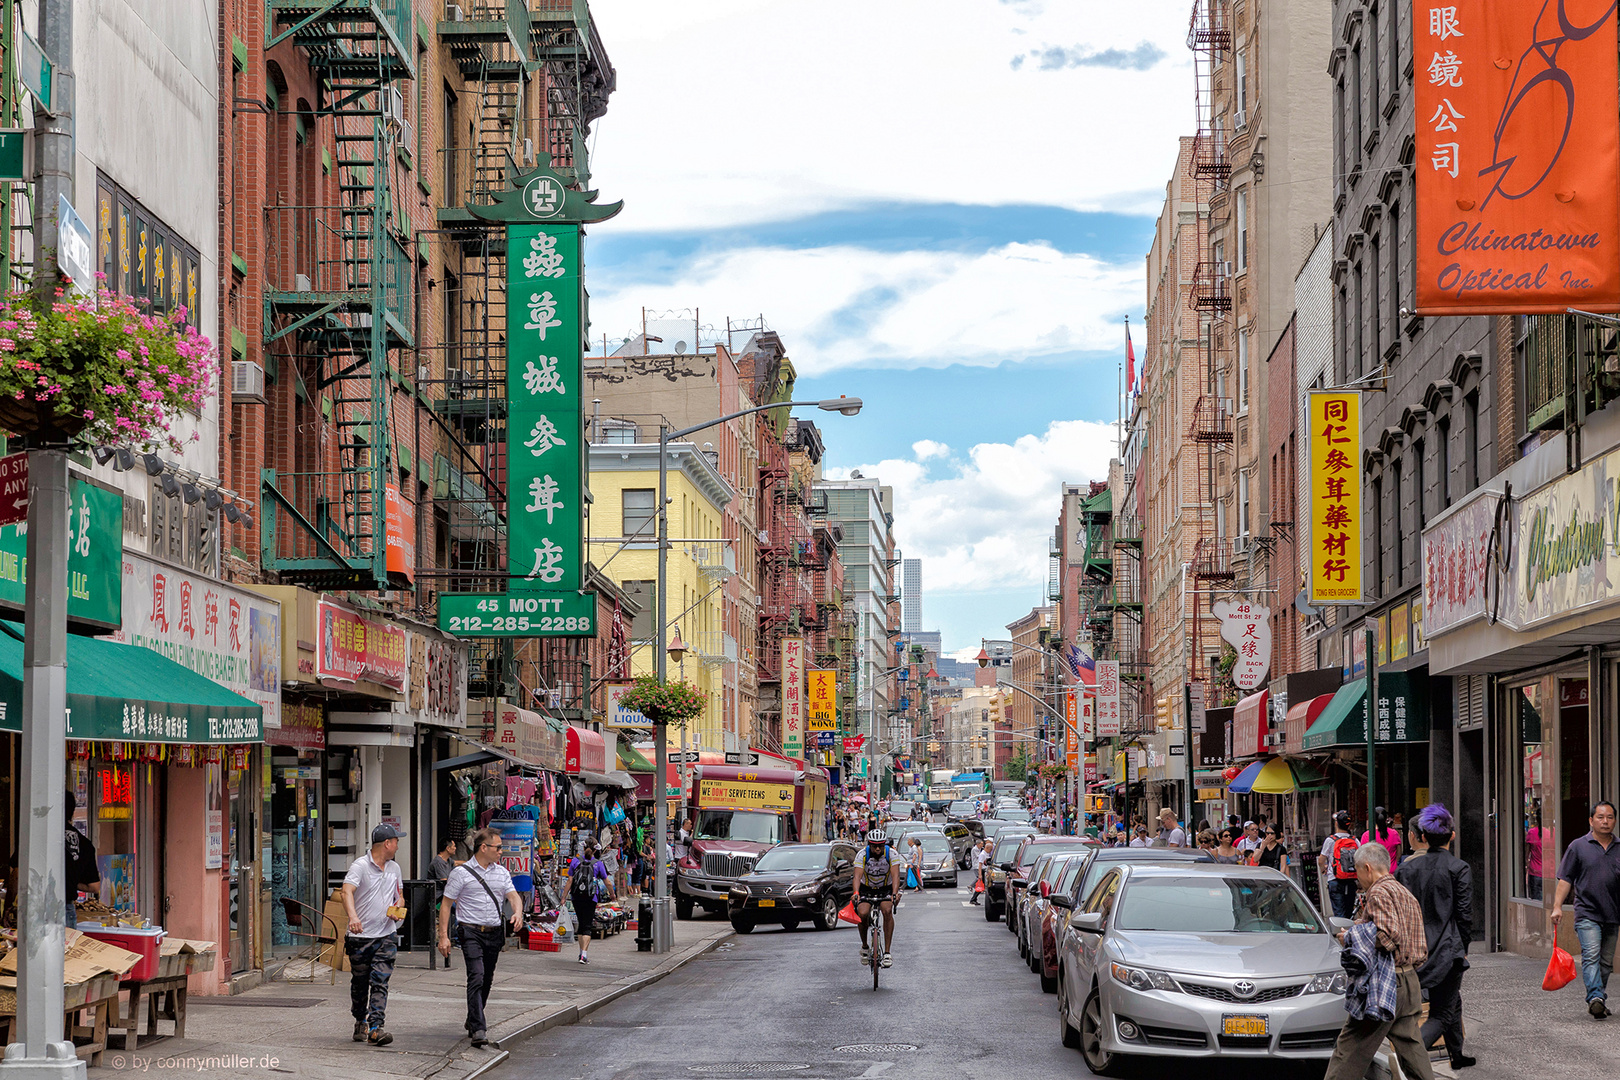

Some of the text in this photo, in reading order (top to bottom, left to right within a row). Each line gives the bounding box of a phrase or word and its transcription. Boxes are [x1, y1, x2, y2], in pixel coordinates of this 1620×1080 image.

[1437, 221, 1601, 256] Chinatown
[1437, 262, 1595, 299] Optical Inc.
[1526, 506, 1605, 602] Chinatown
[1338, 588, 1358, 597] GROCERY
[476, 598, 564, 613] 45 MOTT
[1237, 605, 1251, 613] 48
[449, 616, 591, 631] 212-285-2288
[815, 711, 830, 719] BIG
[207, 717, 222, 739] TEL:
[222, 717, 259, 739] 212-285-2288
[811, 720, 835, 728] WONG
[738, 772, 758, 781] E 167
[702, 787, 766, 799] WE DON'T SERVE TEENS
[497, 810, 529, 820] ATM
[575, 809, 594, 819] NYPD
[497, 857, 530, 873] TM
[1246, 1020, 1264, 1033] 1912
